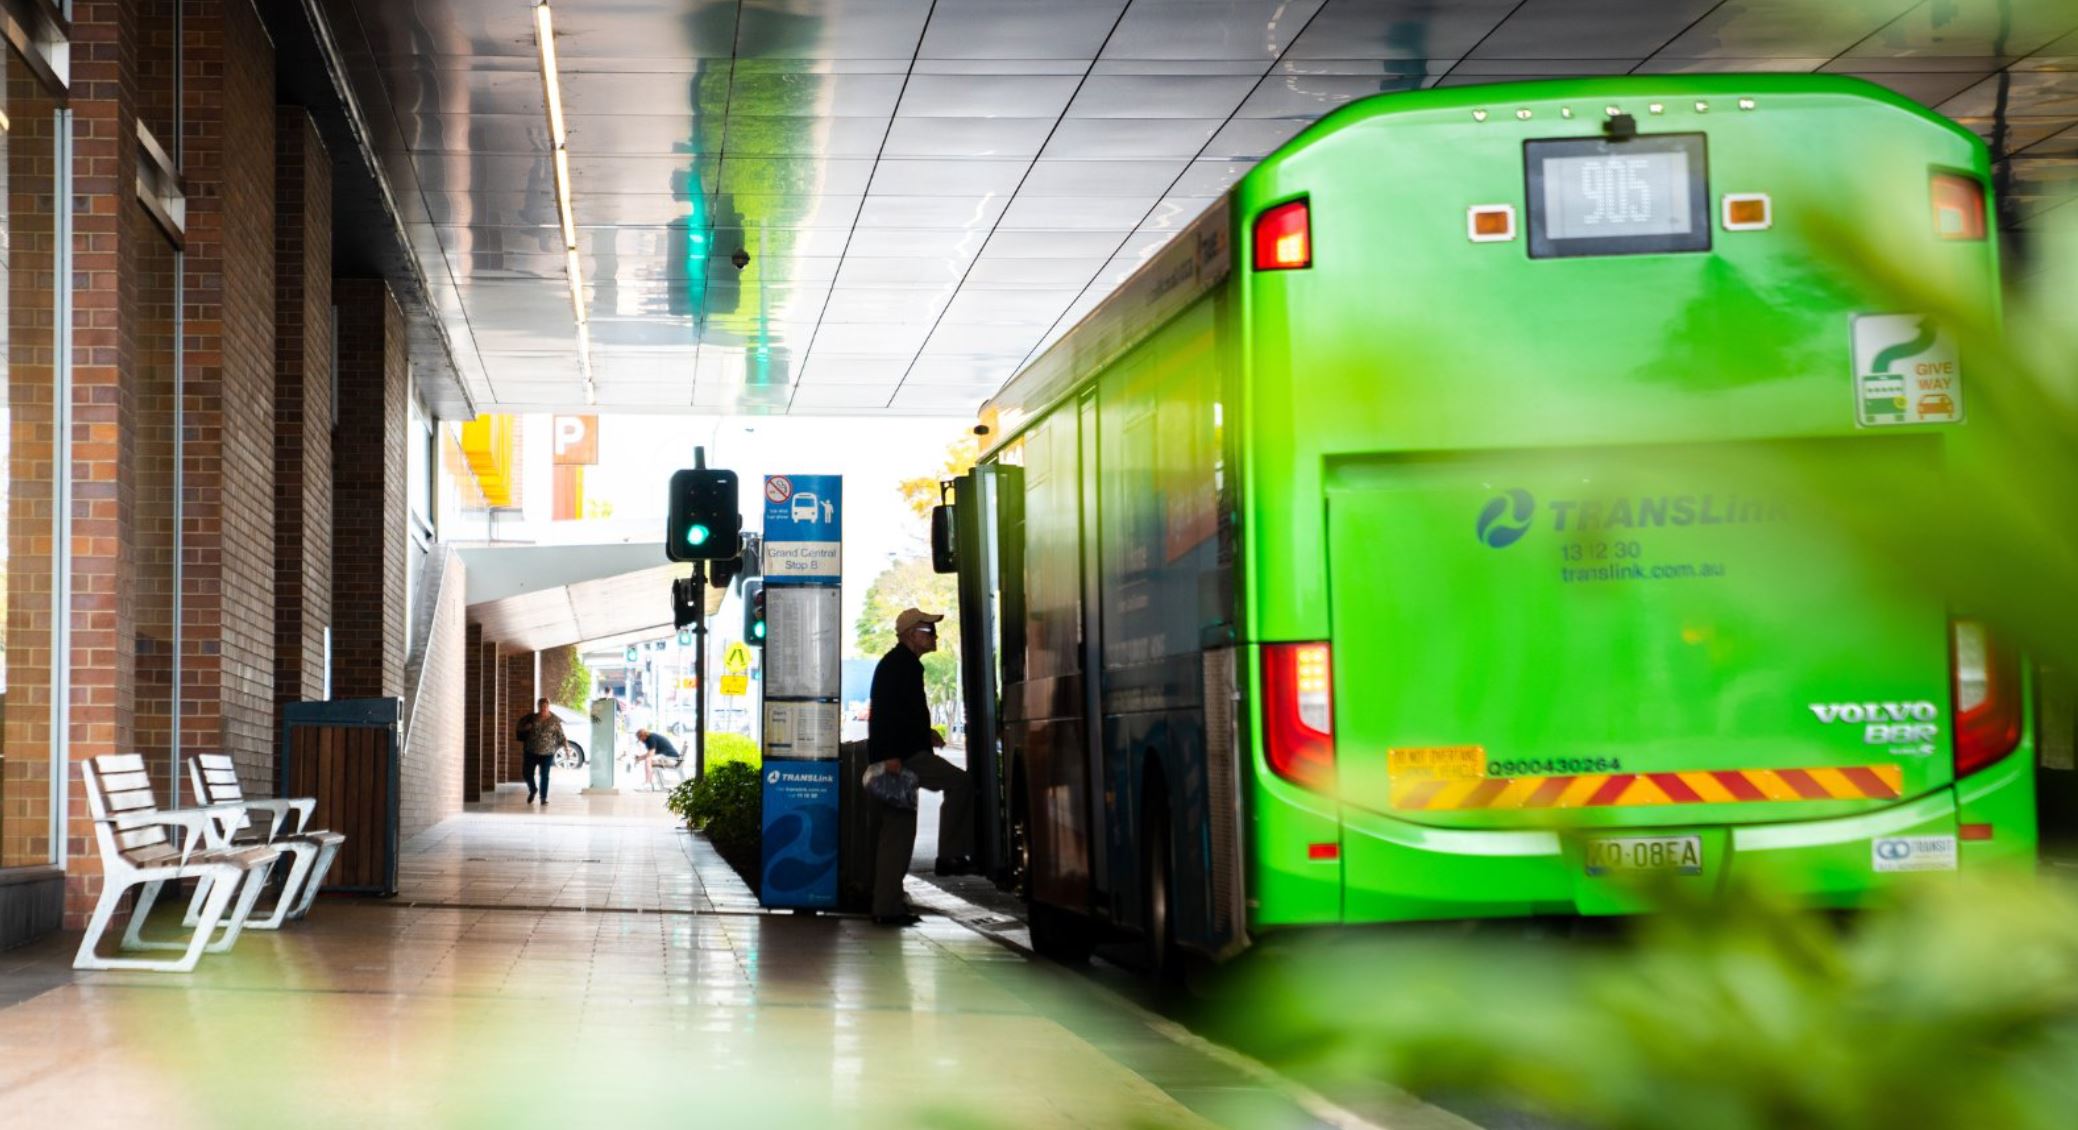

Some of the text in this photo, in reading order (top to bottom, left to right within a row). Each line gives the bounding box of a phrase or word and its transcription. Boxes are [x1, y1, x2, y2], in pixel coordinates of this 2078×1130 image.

[1581, 160, 1651, 224] 905
[1915, 362, 1953, 376] GIVE
[1918, 377, 1951, 390] WAY
[555, 416, 585, 455] P
[768, 548, 836, 557] Grand Central
[1561, 543, 1584, 562] 13
[1613, 541, 1643, 559] 30
[785, 560, 808, 570] Stop
[1561, 562, 1726, 582] translink.com.au
[1808, 701, 1939, 724] VOLVO
[1487, 758, 1622, 776] Q900430264
[782, 773, 834, 782] TRANSLink
